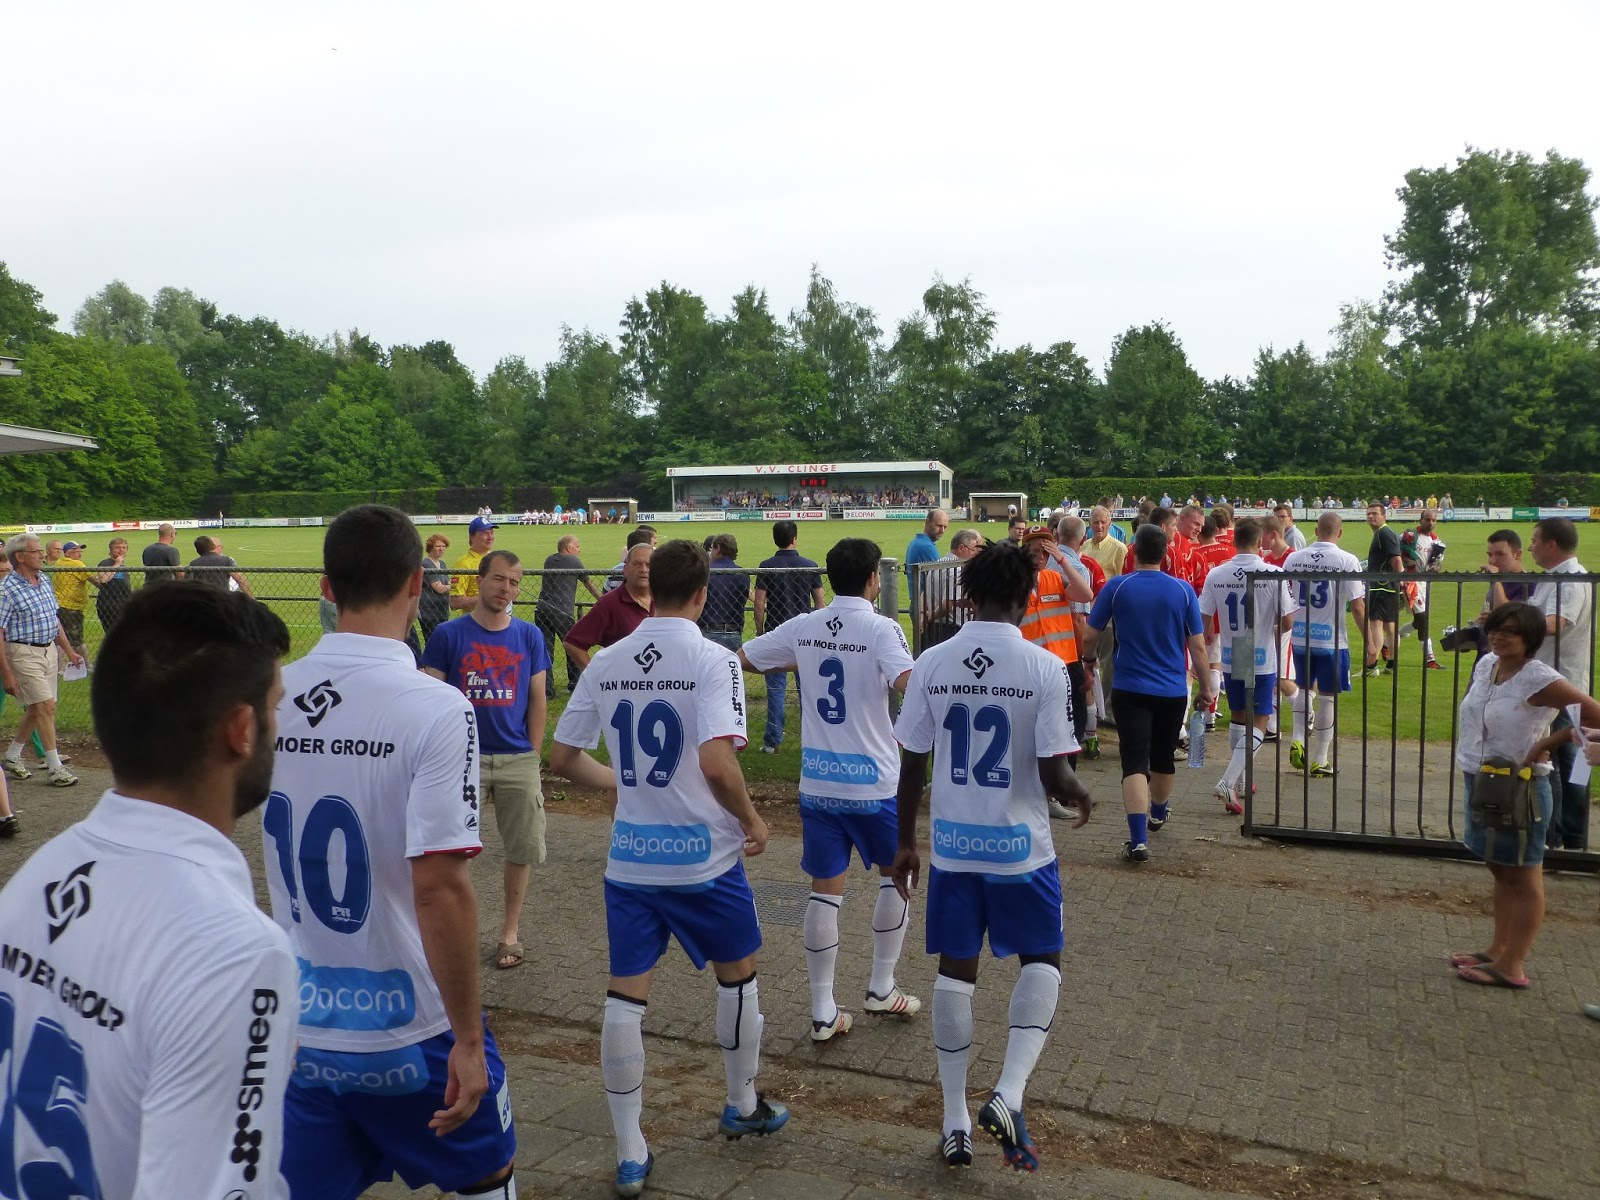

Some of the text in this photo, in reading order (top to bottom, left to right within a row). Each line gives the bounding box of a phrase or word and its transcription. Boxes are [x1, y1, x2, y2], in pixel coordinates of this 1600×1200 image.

[755, 464, 837, 474] V.V. CLINGE
[797, 638, 867, 653] VAN MOER GROUP
[600, 680, 696, 691] VAN MOER GROUP
[728, 660, 739, 697] smeg
[816, 656, 847, 725] 3
[928, 684, 1034, 700] VAN MOER GROUP
[465, 689, 513, 700] STATE
[330, 739, 396, 759] GROUP
[463, 711, 476, 775] smeg
[610, 699, 684, 788] 19
[942, 702, 1011, 789] 12
[802, 751, 875, 775] belgacom
[936, 824, 1027, 855] belgacom
[263, 790, 372, 935] 10
[237, 988, 278, 1111] smeg
